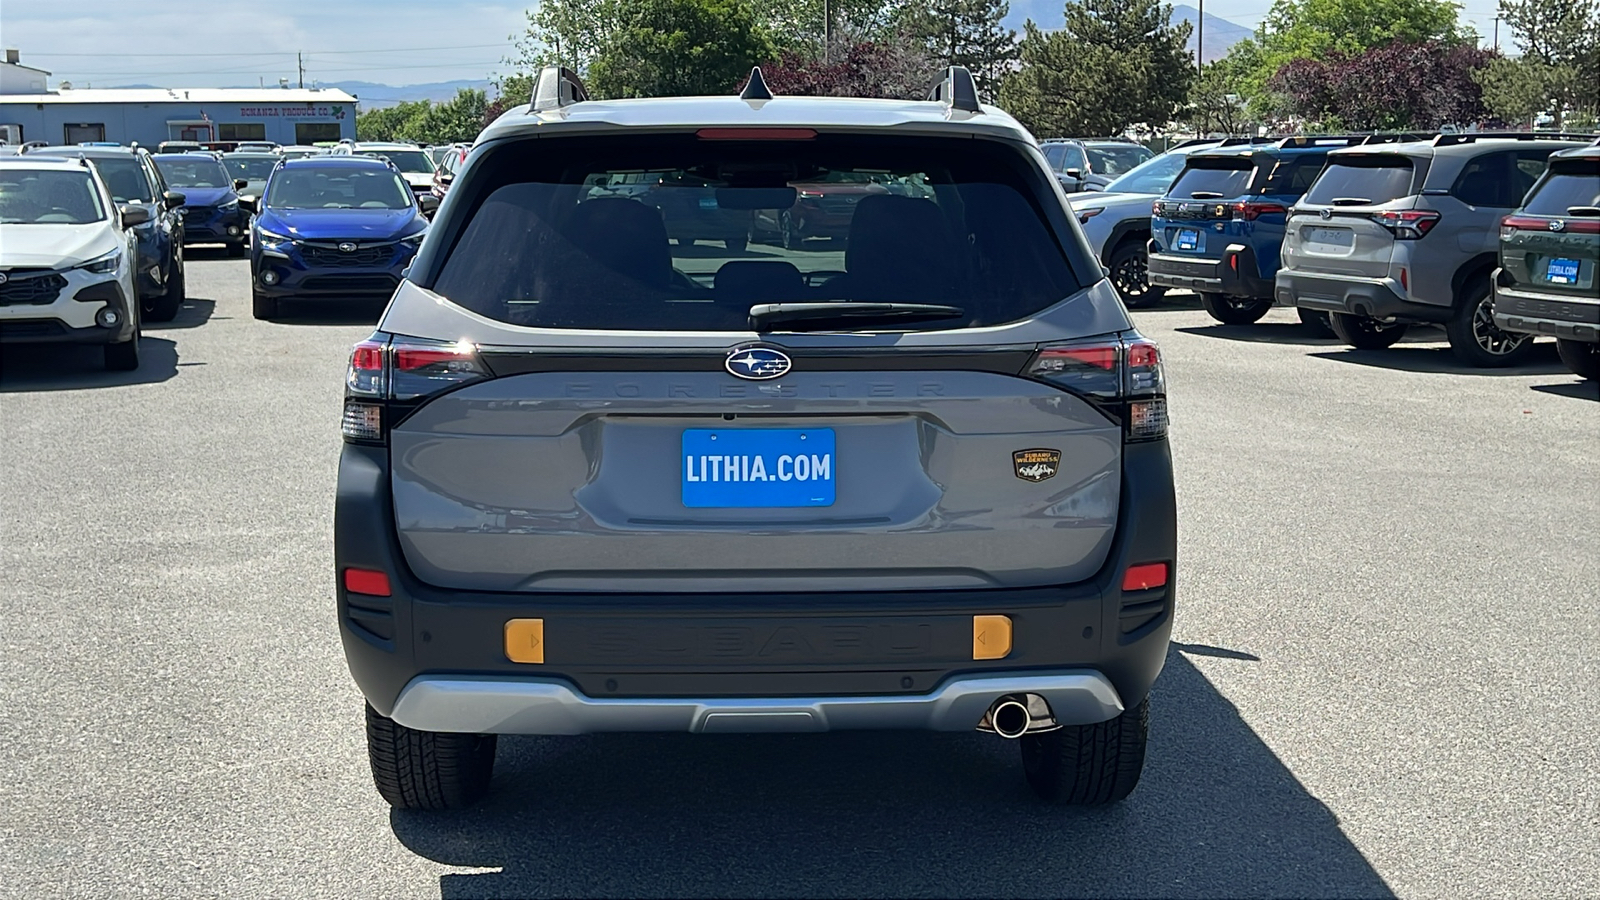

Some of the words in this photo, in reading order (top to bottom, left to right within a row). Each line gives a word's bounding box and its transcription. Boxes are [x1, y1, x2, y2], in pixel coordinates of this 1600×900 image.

[240, 107, 279, 117] BONANZA
[282, 107, 316, 117] PRODUCE
[1547, 265, 1578, 276] LITHIA.COM
[565, 382, 946, 398] FORESTER
[686, 454, 831, 482] LITHIA.COM
[587, 623, 933, 657] SUBARU
